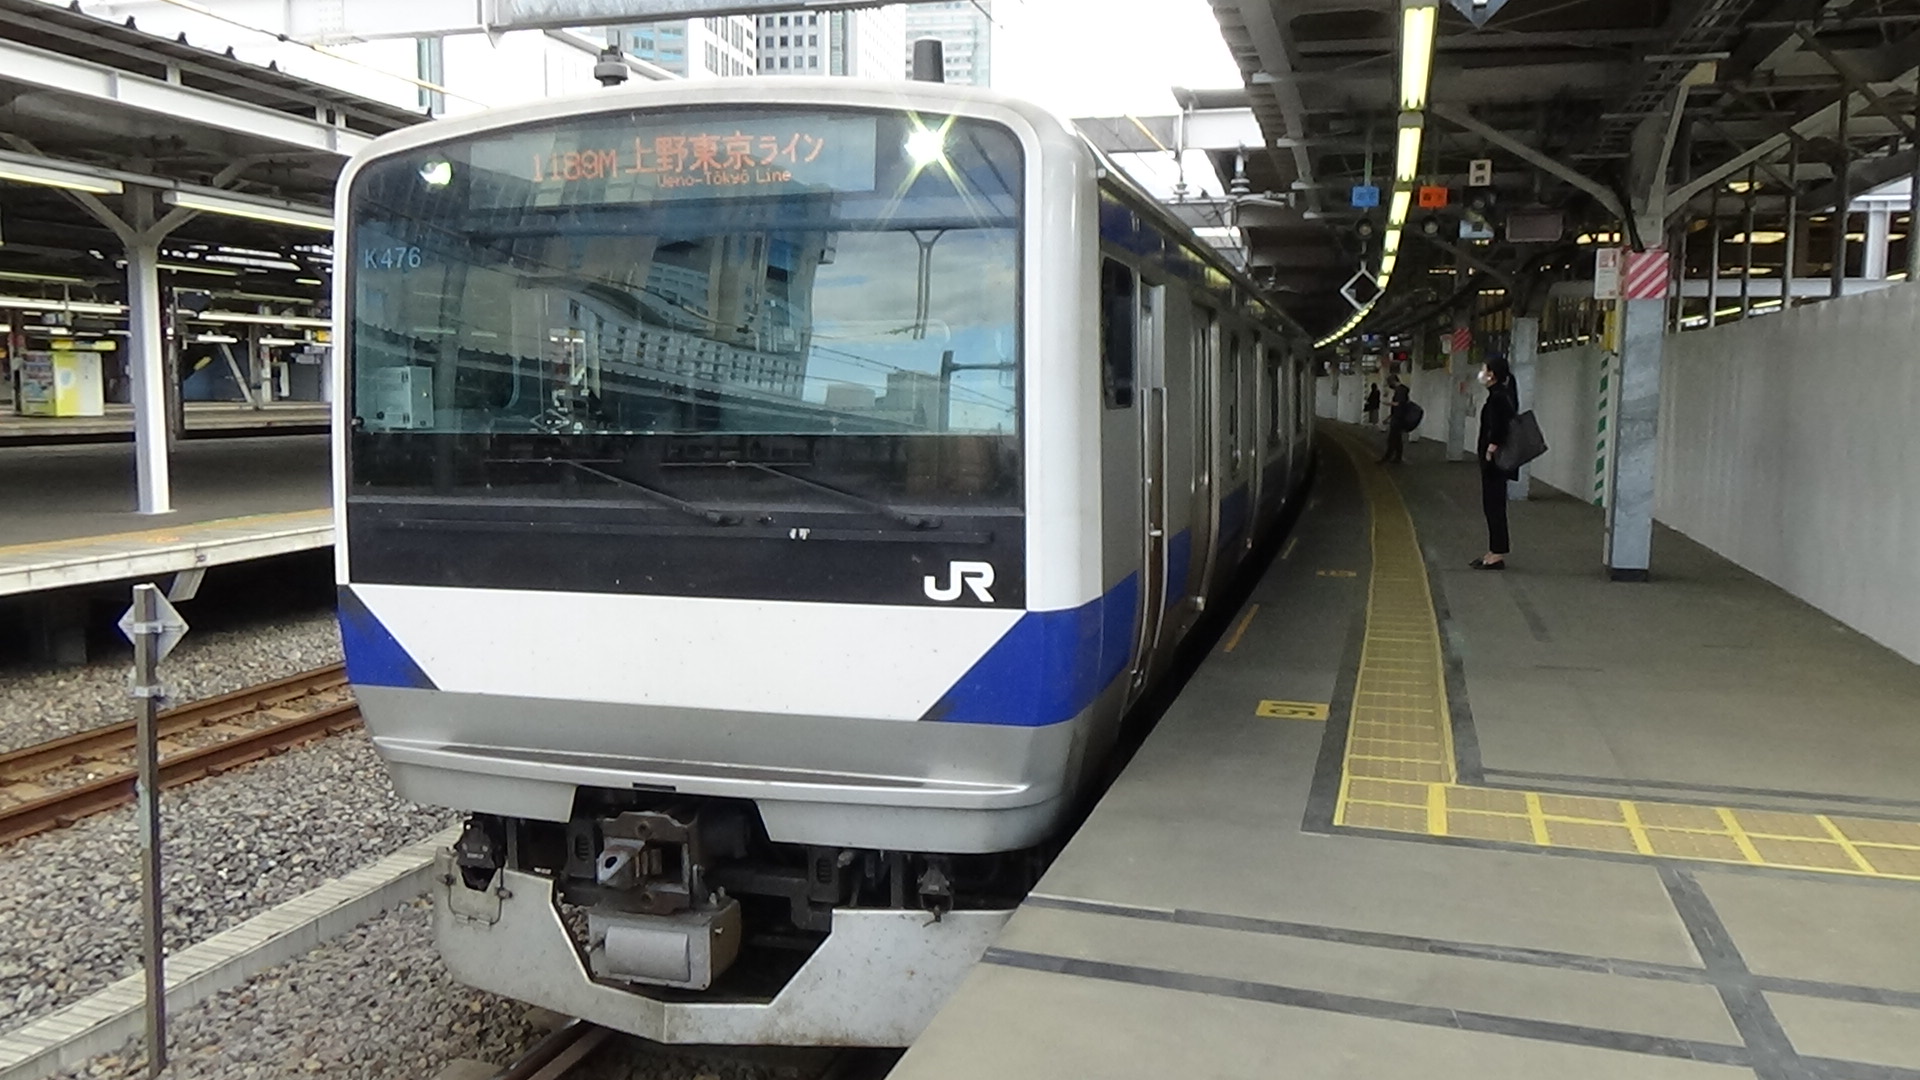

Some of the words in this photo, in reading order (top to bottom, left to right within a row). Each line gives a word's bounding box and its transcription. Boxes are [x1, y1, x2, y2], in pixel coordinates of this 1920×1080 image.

[625, 130, 824, 175] 上野東京ライン
[755, 167, 792, 184] Line
[364, 246, 422, 270] K476
[923, 560, 996, 603] JR
